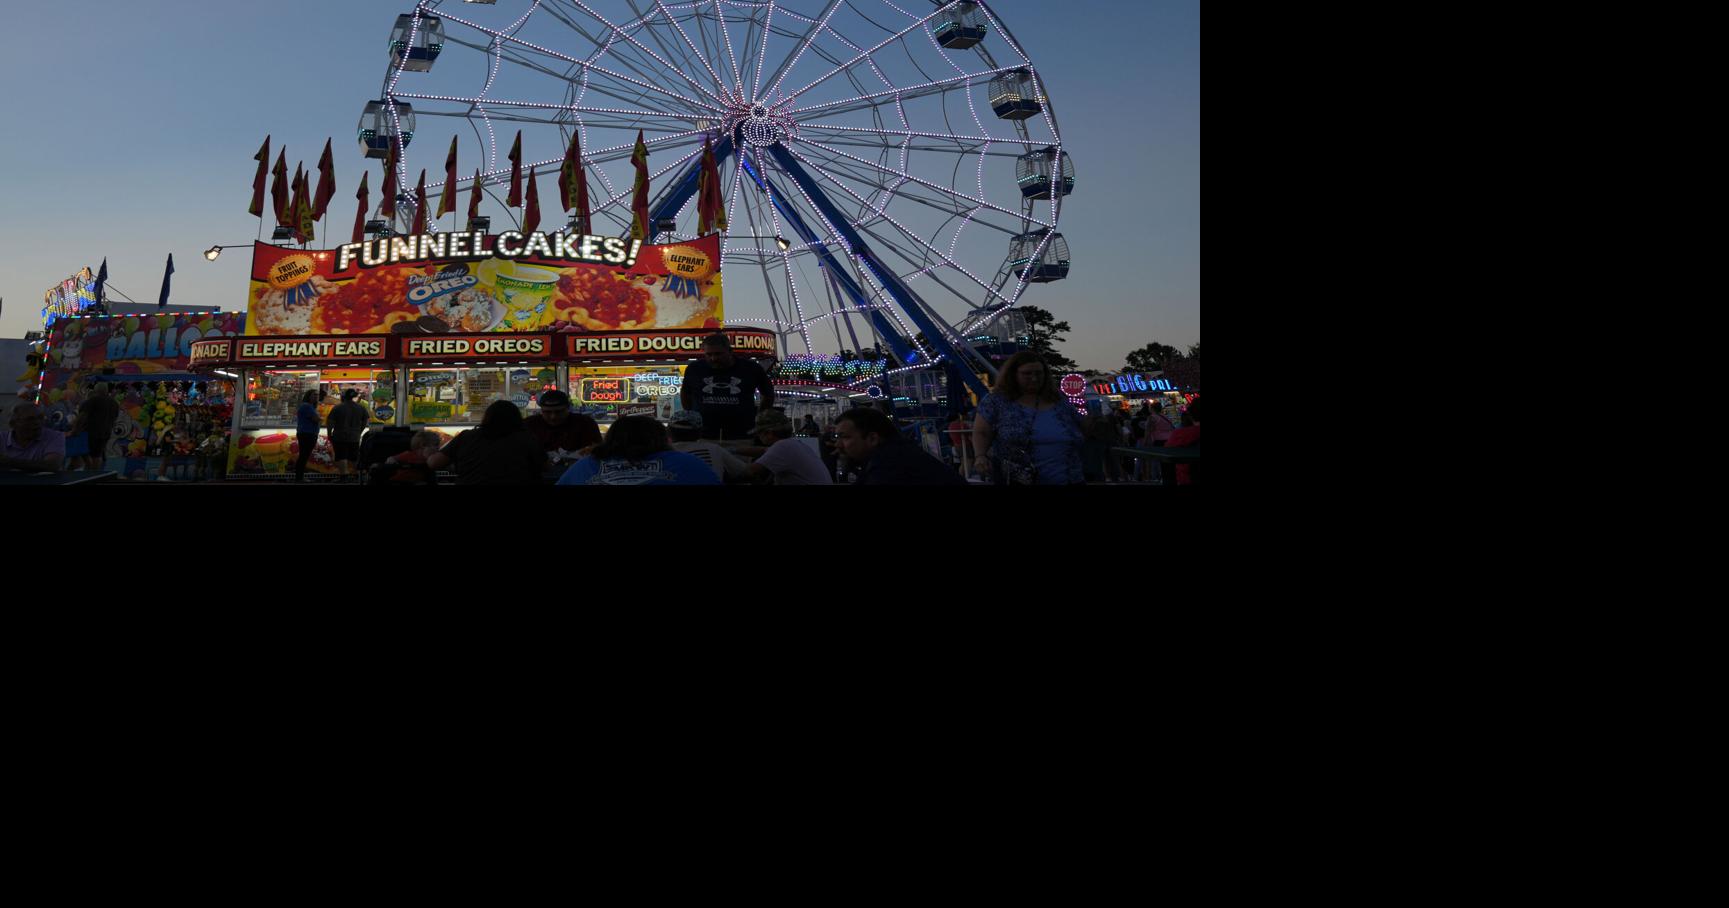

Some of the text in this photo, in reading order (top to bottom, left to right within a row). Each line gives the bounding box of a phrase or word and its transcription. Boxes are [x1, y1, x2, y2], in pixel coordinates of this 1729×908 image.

[338, 231, 494, 270] FUNNEL
[497, 230, 643, 266] CAKES!
[670, 254, 705, 267] ELEPHANT
[275, 265, 309, 284] TOPPINGS
[277, 261, 298, 275] FRUIT
[677, 264, 695, 273] EARS
[408, 275, 477, 302] OREO
[106, 327, 240, 361] BALLO
[242, 341, 381, 357] ELEPHANT EARS
[409, 339, 543, 354] FRIED OREOS
[575, 338, 634, 352] FRIED
[634, 373, 659, 382] DEEP
[1116, 373, 1148, 393] BIG
[1150, 378, 1178, 391] PRI
[593, 380, 619, 390] Fried
[637, 385, 682, 396] OREO
[1063, 380, 1083, 390] STOP
[590, 391, 623, 401] Dough
